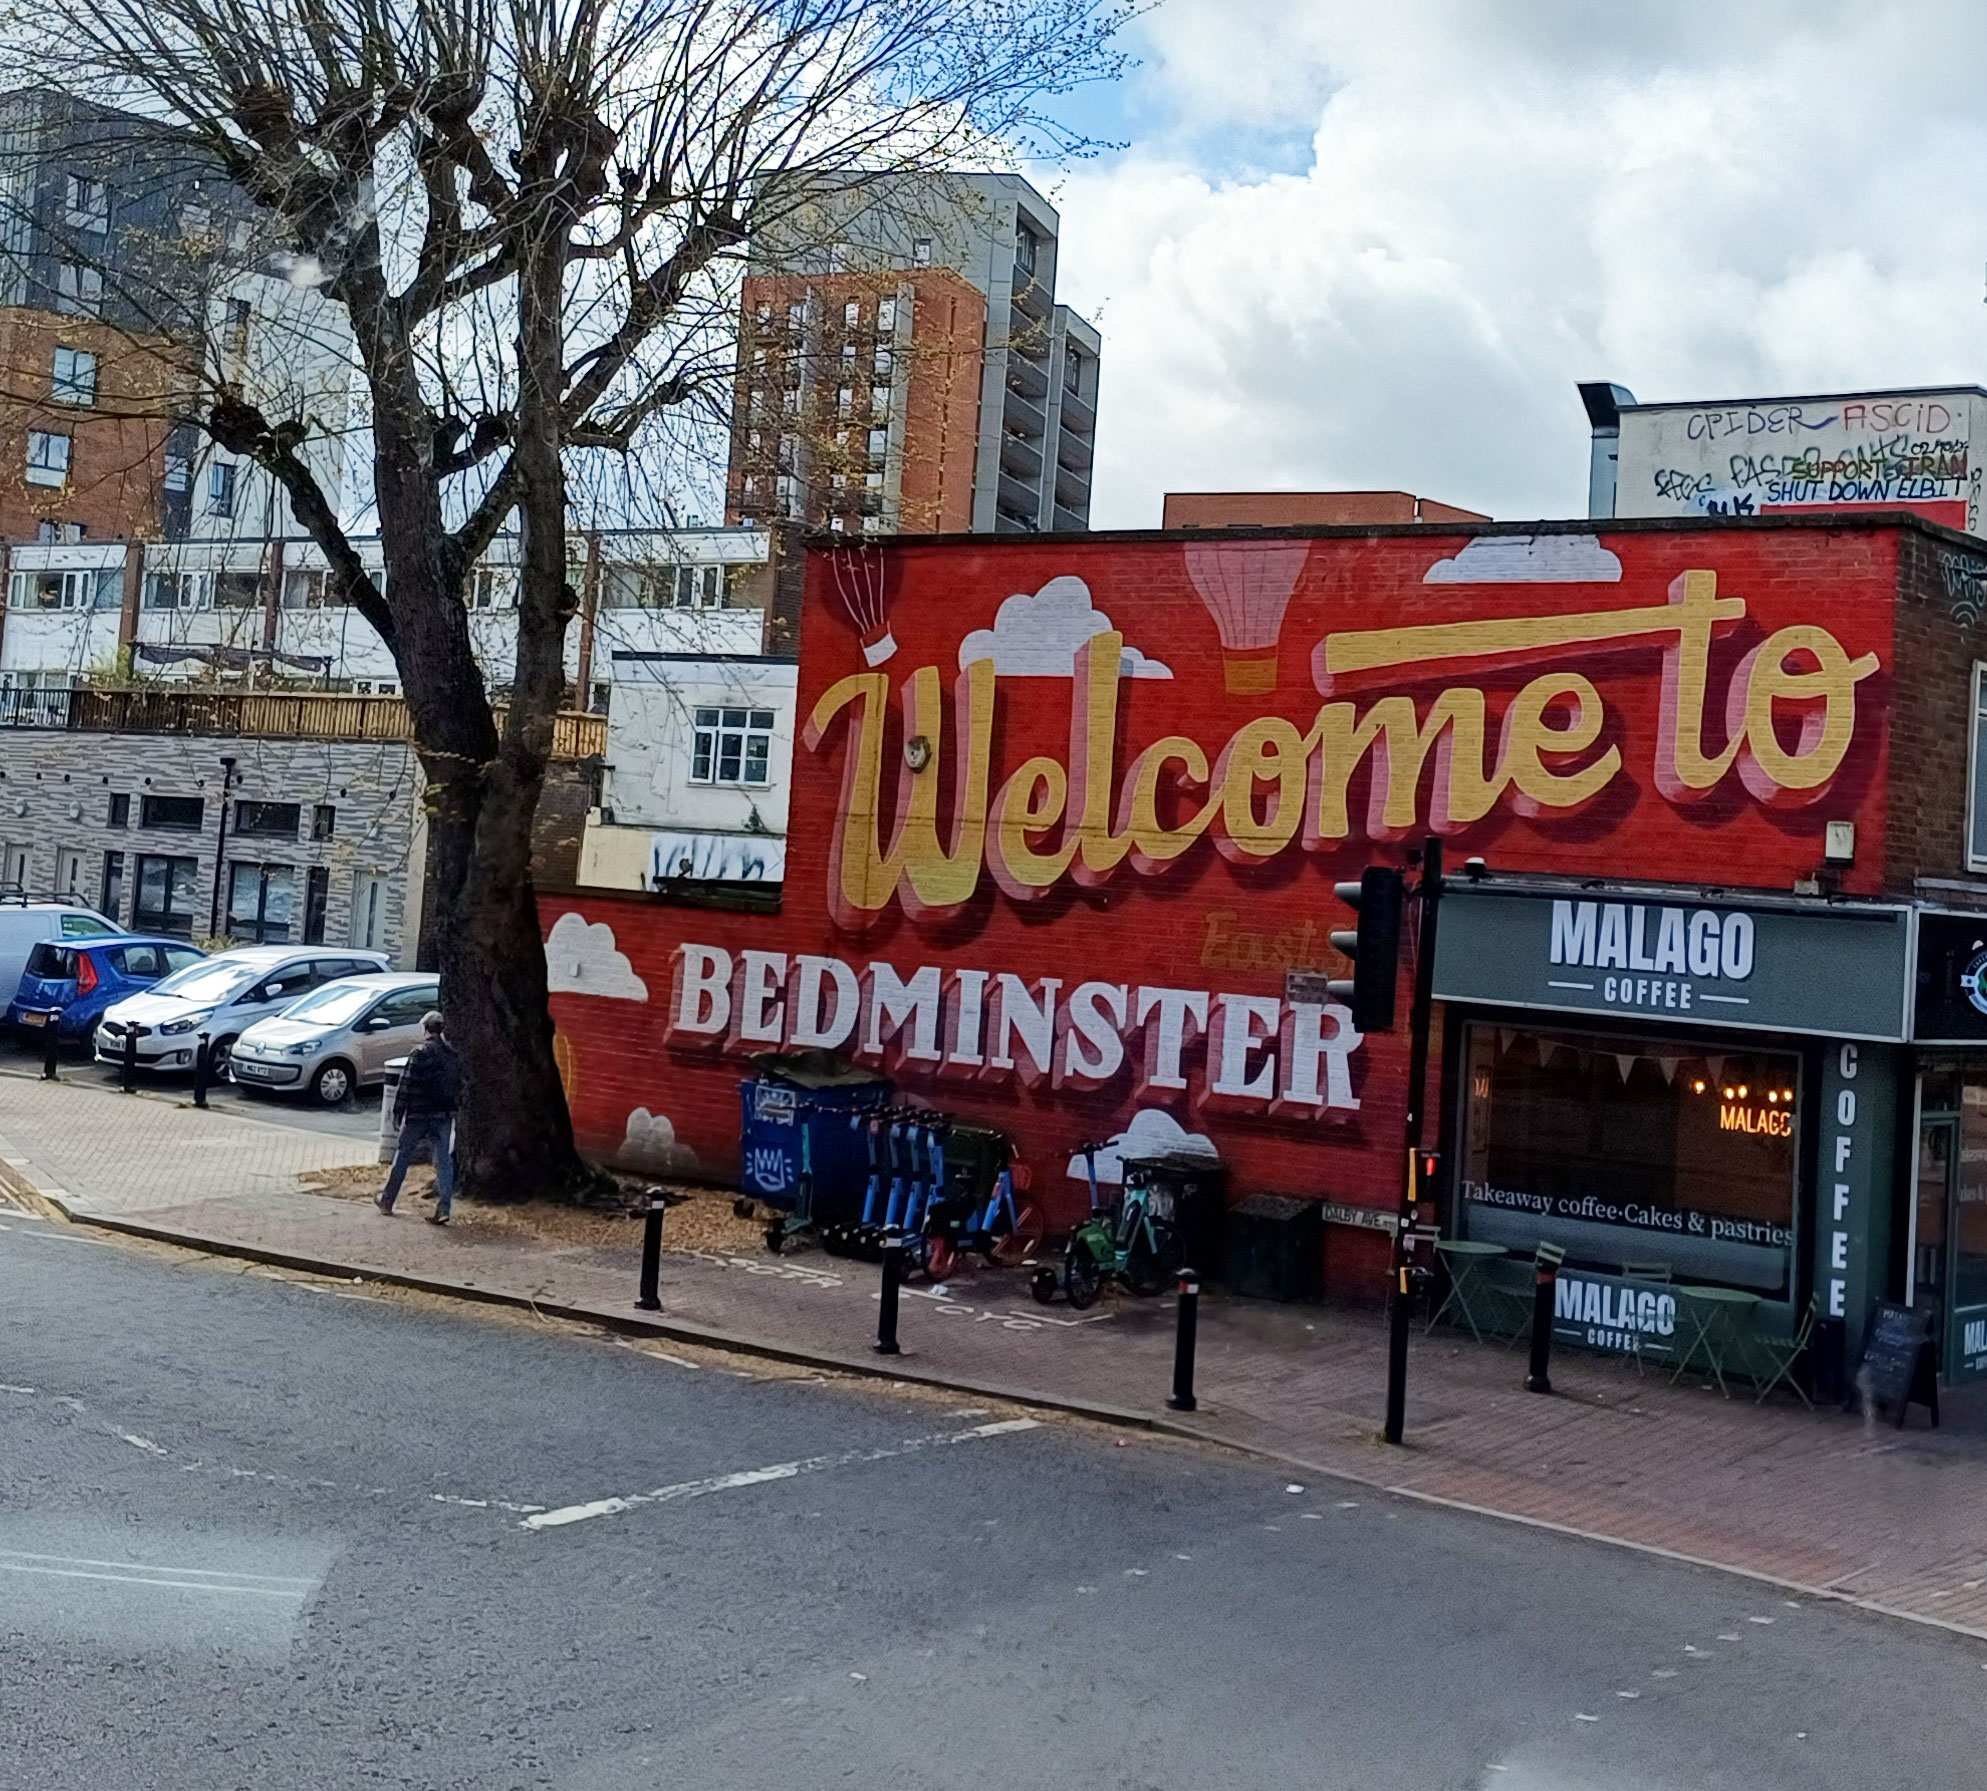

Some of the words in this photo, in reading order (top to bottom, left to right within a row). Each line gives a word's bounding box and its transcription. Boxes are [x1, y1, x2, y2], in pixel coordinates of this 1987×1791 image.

[1767, 480, 1825, 502] SHUT
[1829, 479, 1893, 502] DOWN
[804, 631, 1622, 912] Welcome
[1550, 900, 1755, 980] MALAGO
[1604, 976, 1692, 1009] COFFEE
[673, 942, 1364, 1110] BEDMINSTER
[1462, 1180, 1553, 1216] Takeaway
[1688, 1211, 1704, 1233] &
[1711, 1218, 1794, 1246] pastries
[1829, 1043, 1858, 1317] COFFEE
[1555, 1277, 1676, 1336] MALAGO
[1587, 1328, 1642, 1352] COFFEE
